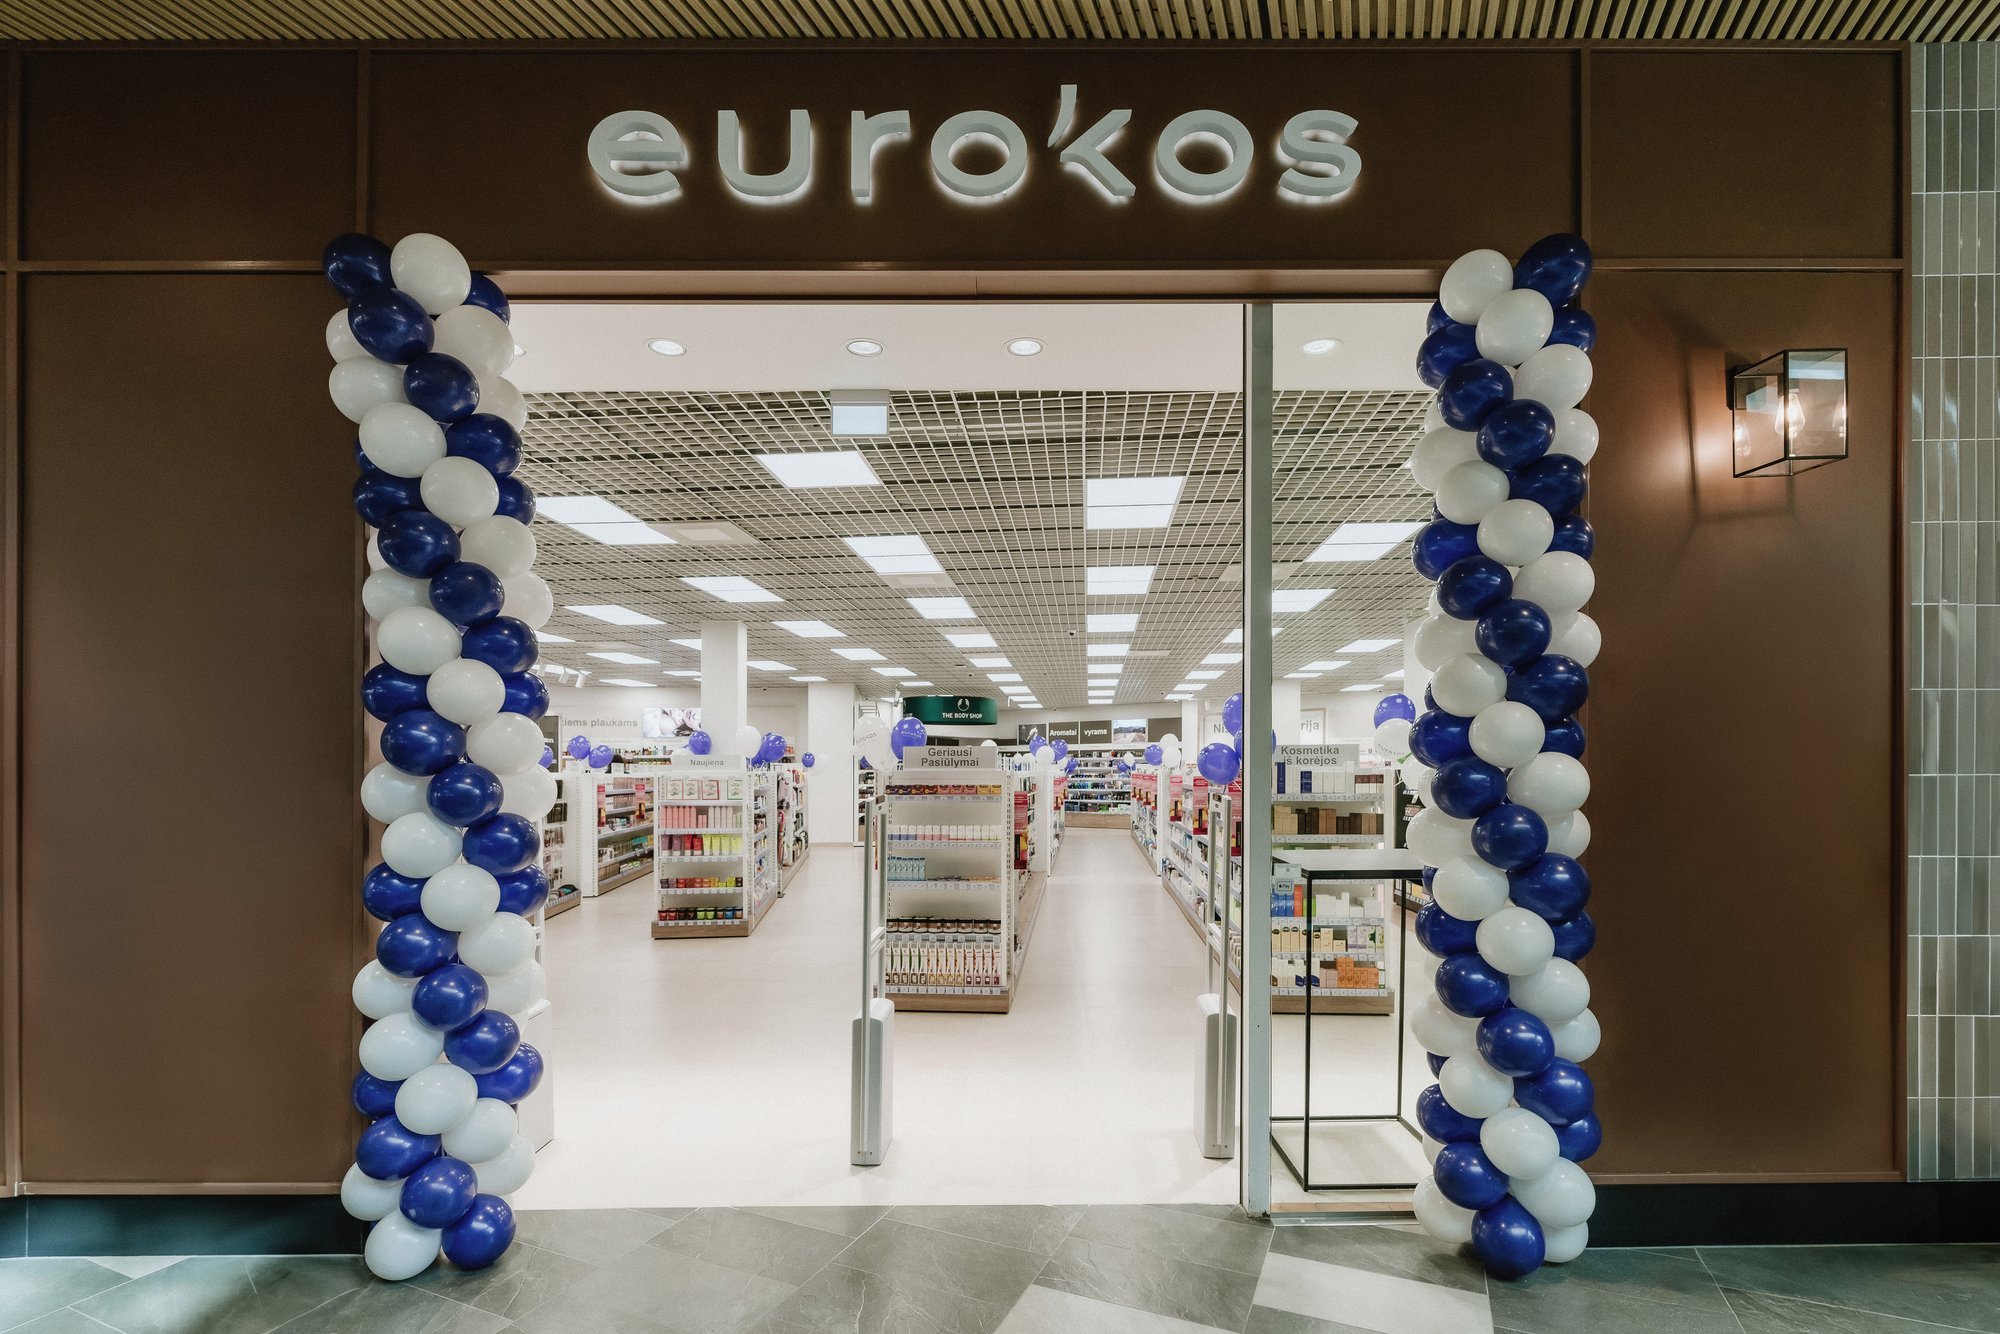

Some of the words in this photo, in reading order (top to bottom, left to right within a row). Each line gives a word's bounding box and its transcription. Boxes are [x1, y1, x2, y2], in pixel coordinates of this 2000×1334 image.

[587, 84, 1363, 199] eurokos
[590, 718, 638, 728] plaukams
[1301, 720, 1320, 732] rija
[1084, 729, 1108, 737] vyrams
[928, 747, 972, 757] Geriausi
[1281, 746, 1340, 755] Kosmetika
[690, 759, 724, 767] Naujiena
[1296, 756, 1337, 767] korėjos
